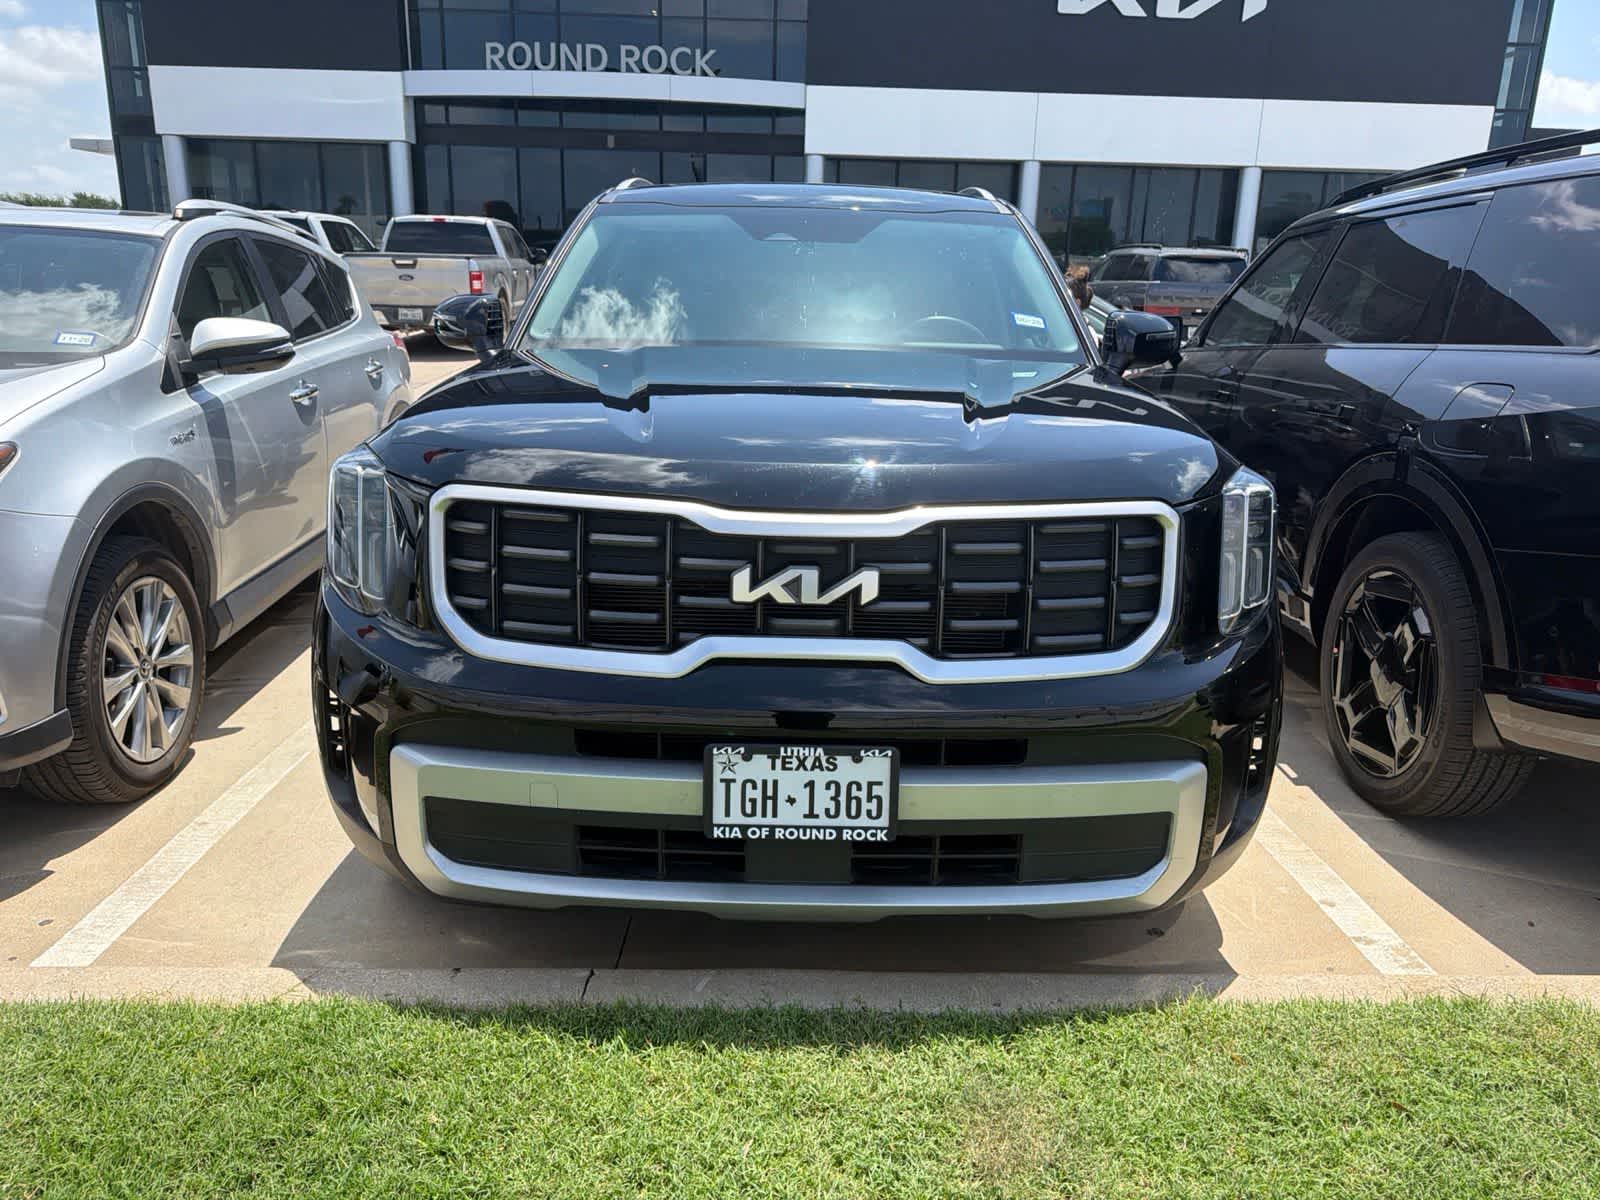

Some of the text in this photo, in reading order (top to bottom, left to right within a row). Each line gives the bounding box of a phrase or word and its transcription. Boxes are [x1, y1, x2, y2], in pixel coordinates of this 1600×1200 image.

[484, 41, 717, 77] ROUND ROCK
[730, 563, 880, 606] KIA
[767, 755, 838, 772] TEXAS
[780, 746, 825, 757] LITHIA
[719, 778, 884, 820] TGH 1365
[713, 826, 888, 841] KIA OF ROUND ROCK
